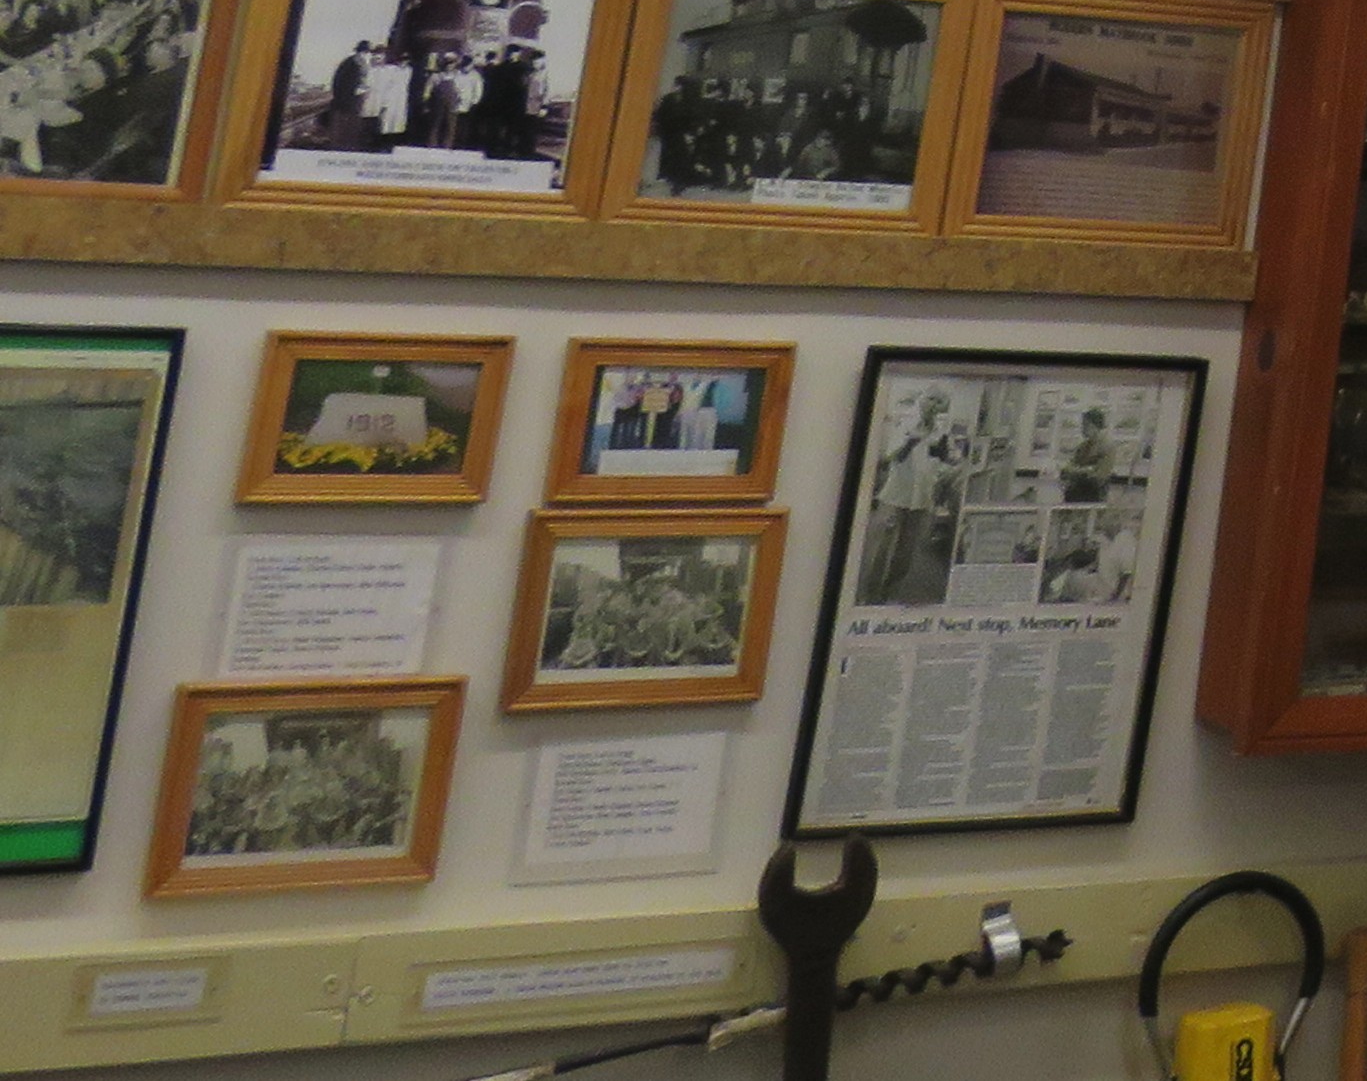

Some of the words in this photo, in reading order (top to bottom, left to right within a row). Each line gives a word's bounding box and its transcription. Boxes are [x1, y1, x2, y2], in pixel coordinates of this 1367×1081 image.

[848, 619, 869, 635] All
[873, 618, 930, 635] aboard!
[977, 617, 1014, 636] stop,
[1018, 615, 1080, 633] Memory
[1085, 614, 1121, 631] Lane
